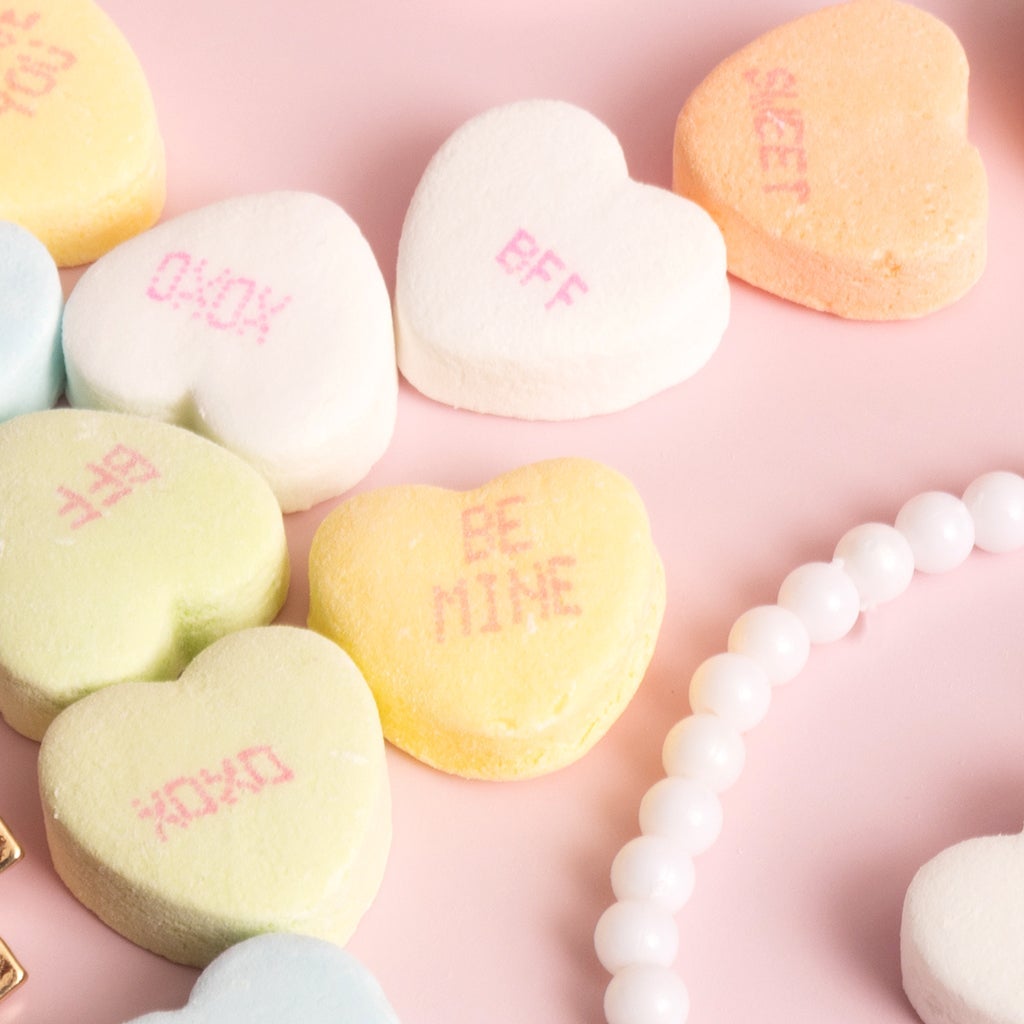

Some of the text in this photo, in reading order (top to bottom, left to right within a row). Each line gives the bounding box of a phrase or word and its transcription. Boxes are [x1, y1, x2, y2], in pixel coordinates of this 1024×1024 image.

[742, 67, 810, 203] SWEET
[146, 251, 293, 344] XOXO
[495, 228, 589, 310] BFF
[57, 443, 161, 530] BFF
[461, 495, 533, 563] BE
[432, 555, 581, 642] MINE
[131, 745, 295, 841] XOXO
